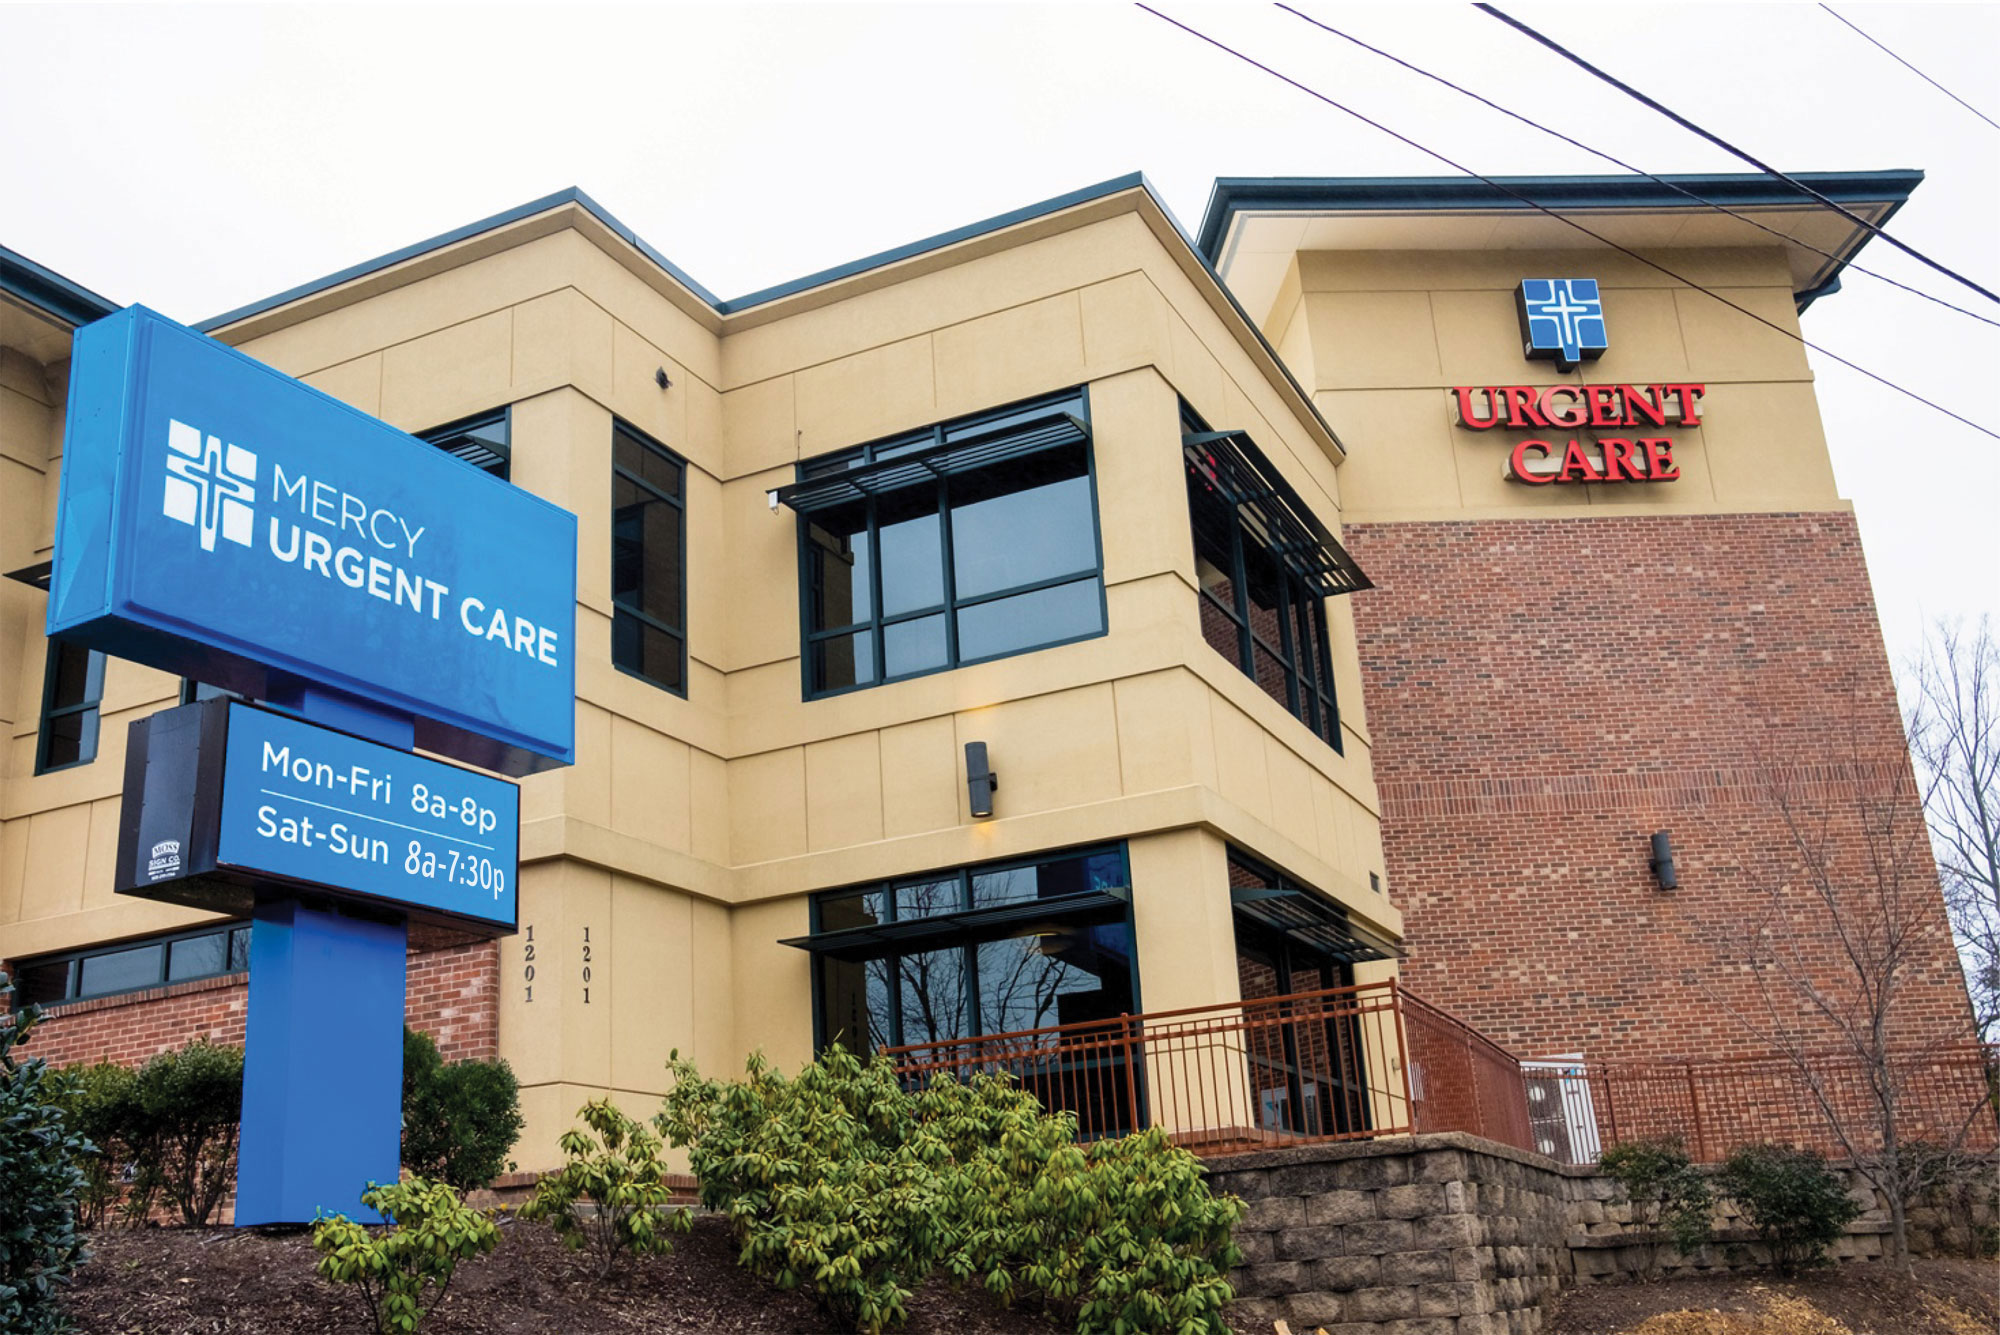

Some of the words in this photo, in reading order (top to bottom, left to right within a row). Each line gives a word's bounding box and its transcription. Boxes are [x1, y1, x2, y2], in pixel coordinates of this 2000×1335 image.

[1451, 384, 1706, 429] URGENT
[1509, 437, 1681, 485] CARE
[273, 463, 425, 559] MERCY
[269, 516, 449, 620] URGENT
[460, 597, 558, 667] CARE
[262, 741, 392, 804] Mon-Fri
[411, 783, 497, 835] 8a-8p
[148, 857, 166, 867] SIGN
[153, 842, 179, 855] MOSS
[256, 805, 390, 865] Sat-Sun
[404, 840, 505, 900] 8a-7:30p
[525, 925, 535, 1003] 1201
[583, 926, 591, 1004] 1201
